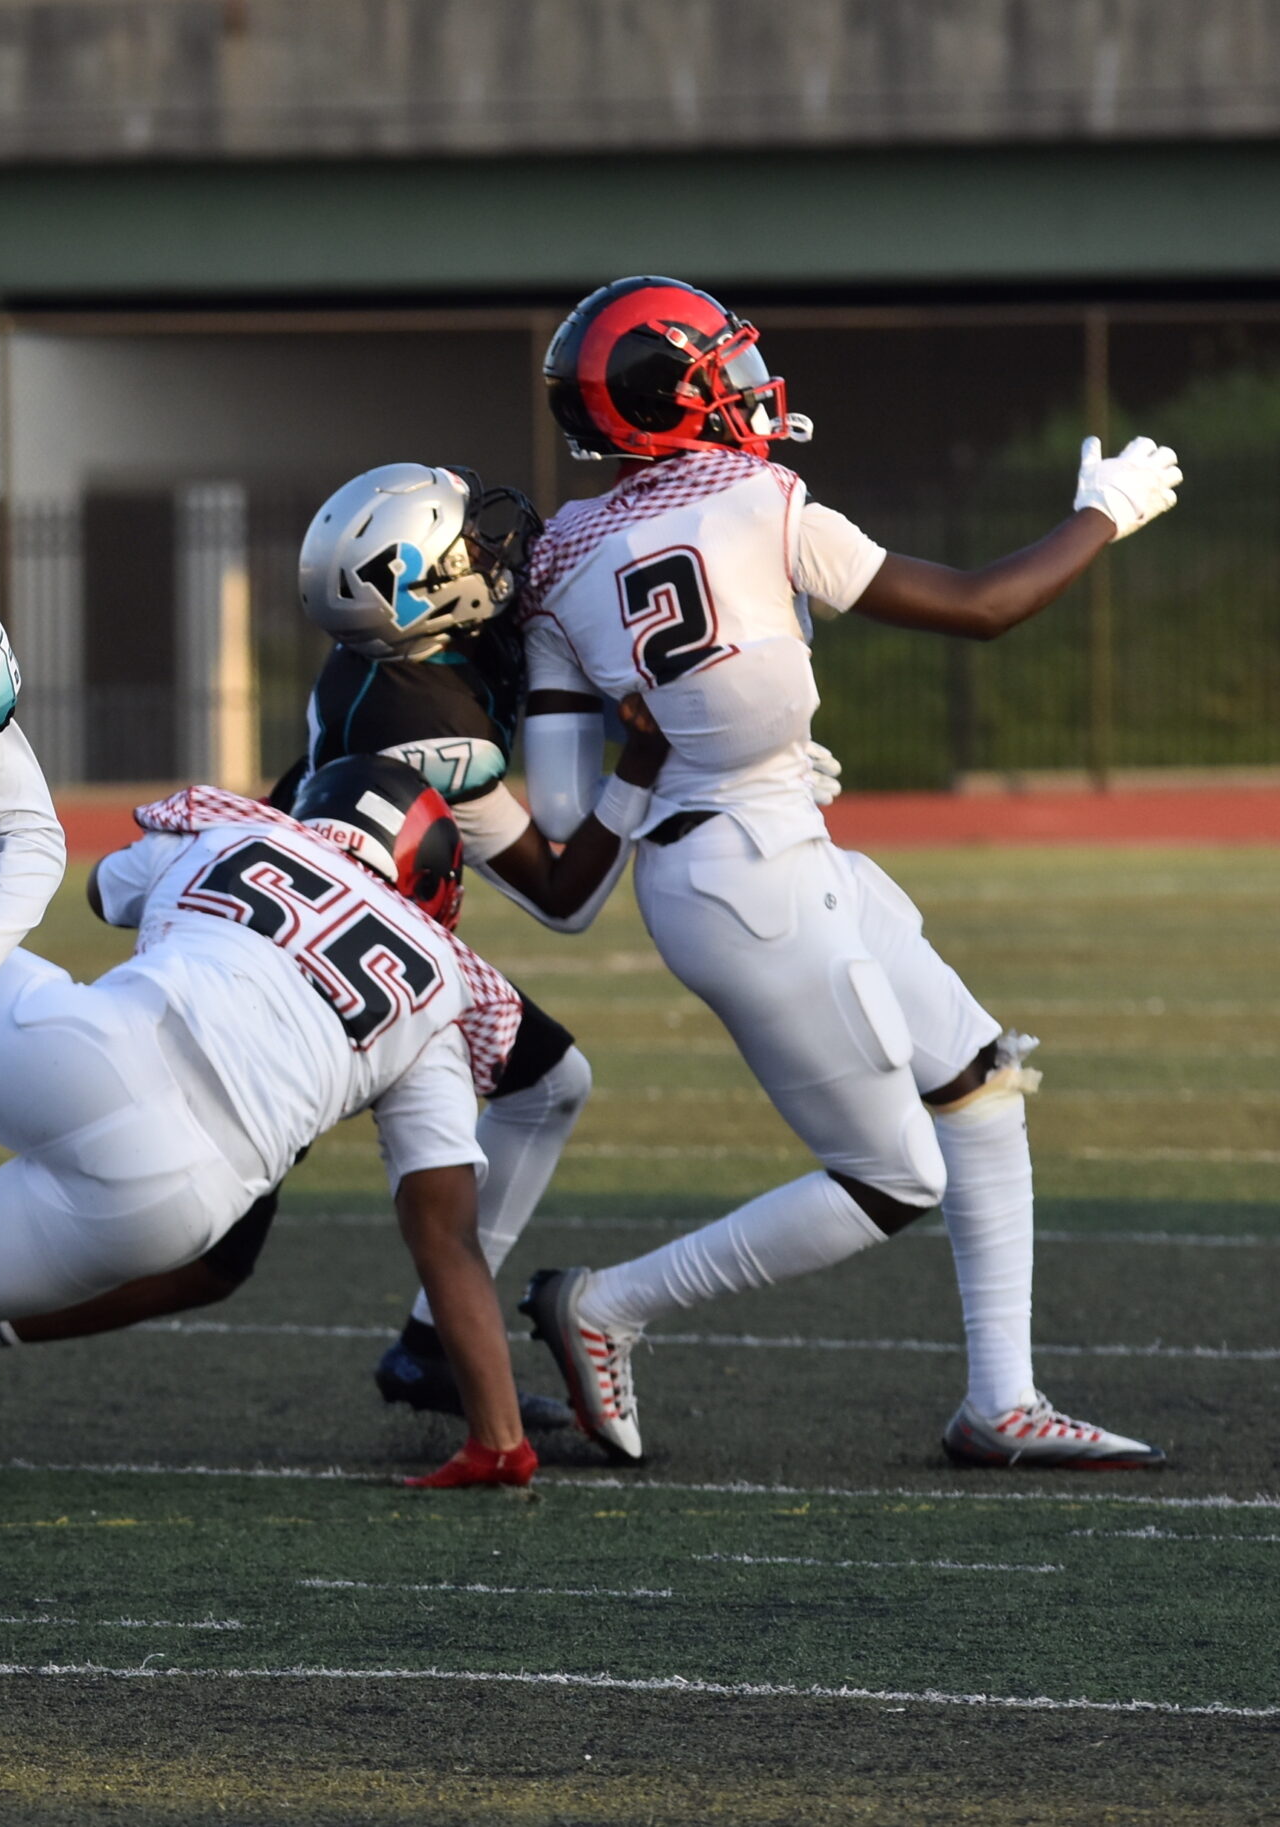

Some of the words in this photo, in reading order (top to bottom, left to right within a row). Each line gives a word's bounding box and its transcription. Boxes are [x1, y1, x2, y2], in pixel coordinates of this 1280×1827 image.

[614, 544, 741, 690] 2
[312, 822, 366, 850] dell
[177, 836, 445, 1052] 55
